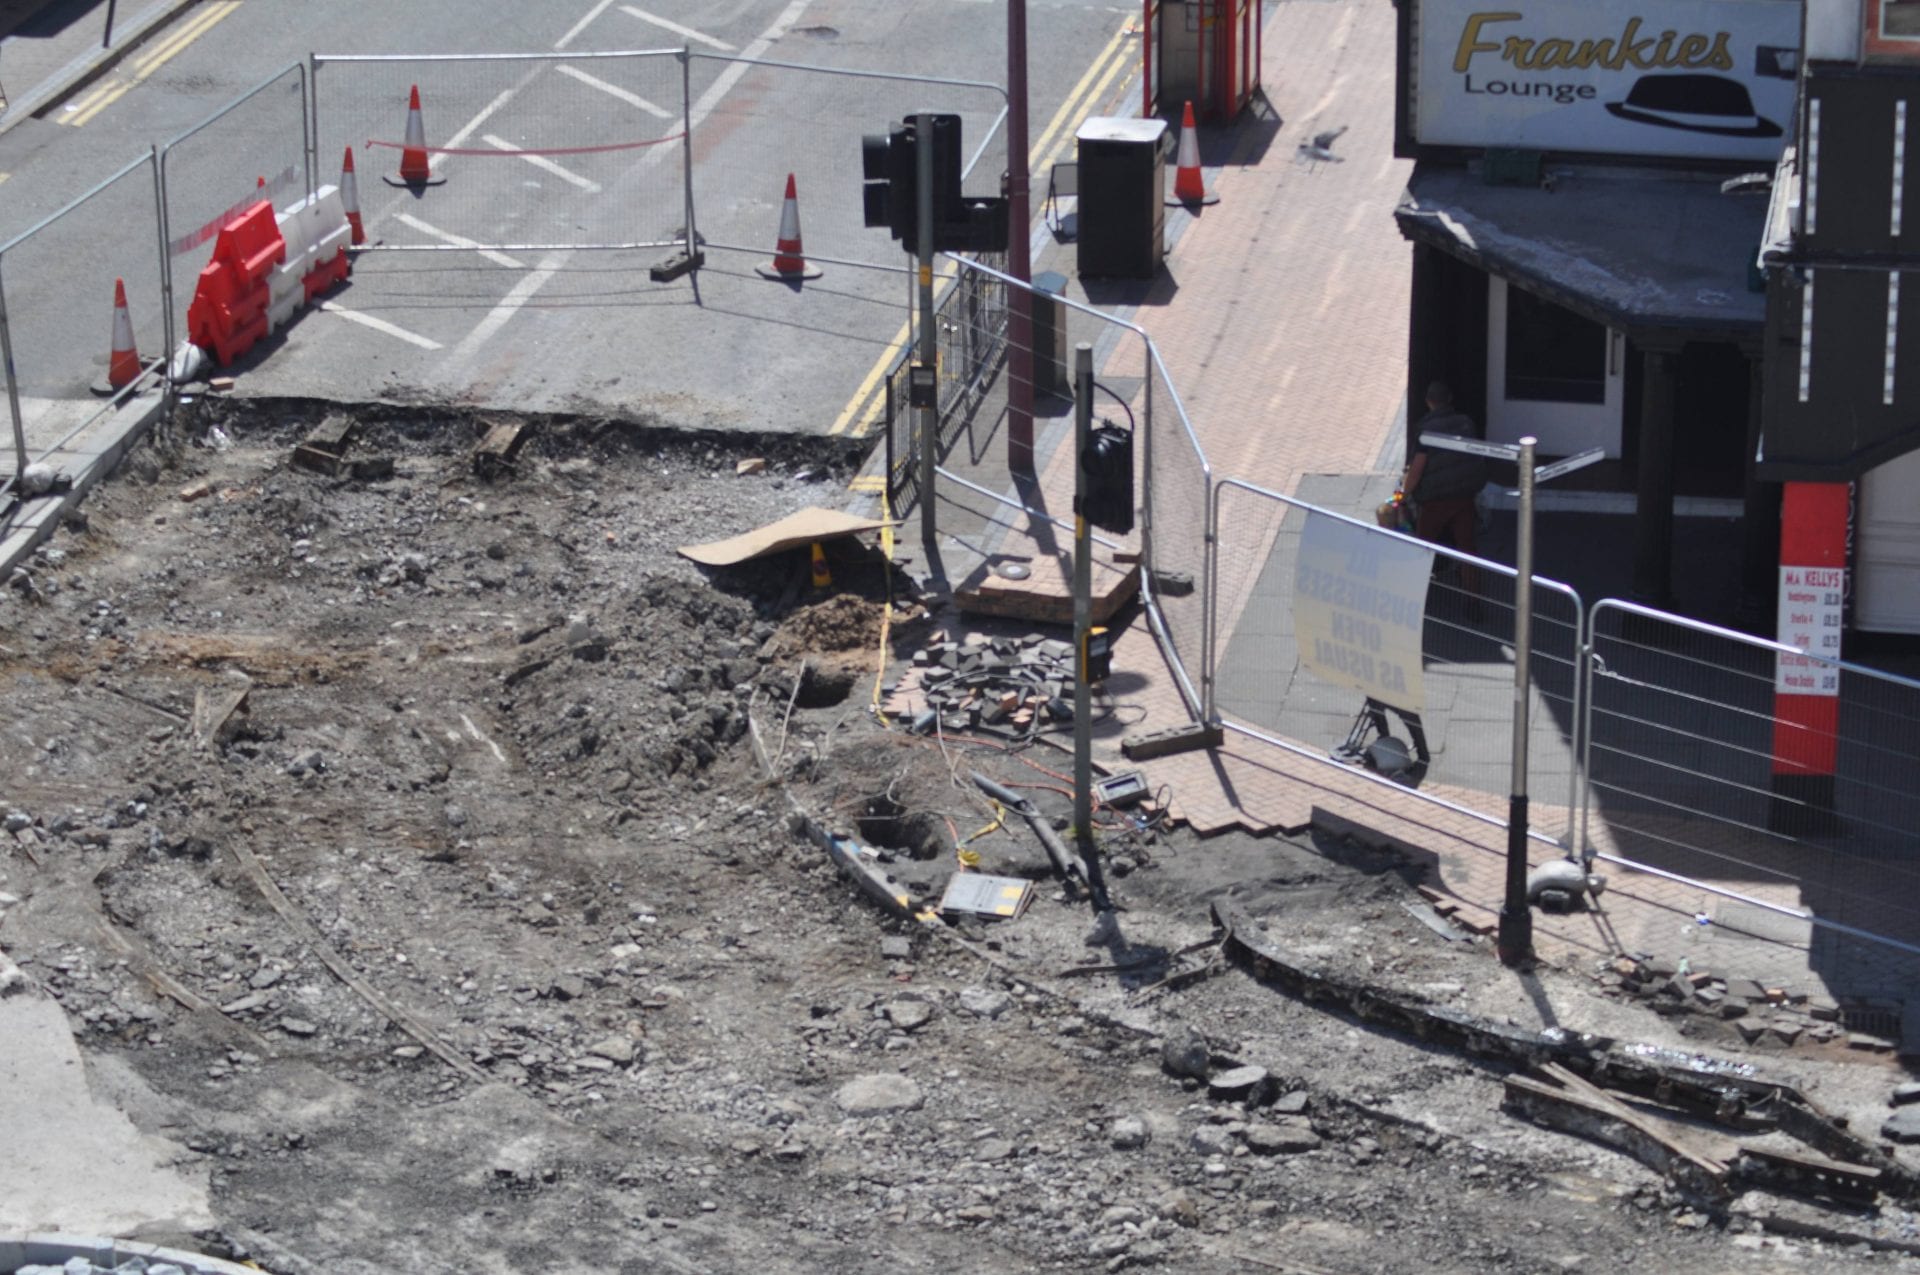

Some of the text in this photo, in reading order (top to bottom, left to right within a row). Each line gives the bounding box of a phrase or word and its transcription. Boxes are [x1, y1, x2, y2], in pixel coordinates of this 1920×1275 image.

[1453, 12, 1734, 73] Frankies
[1465, 74, 1597, 103] Lounge
[1804, 570, 1840, 588] KELLYS
